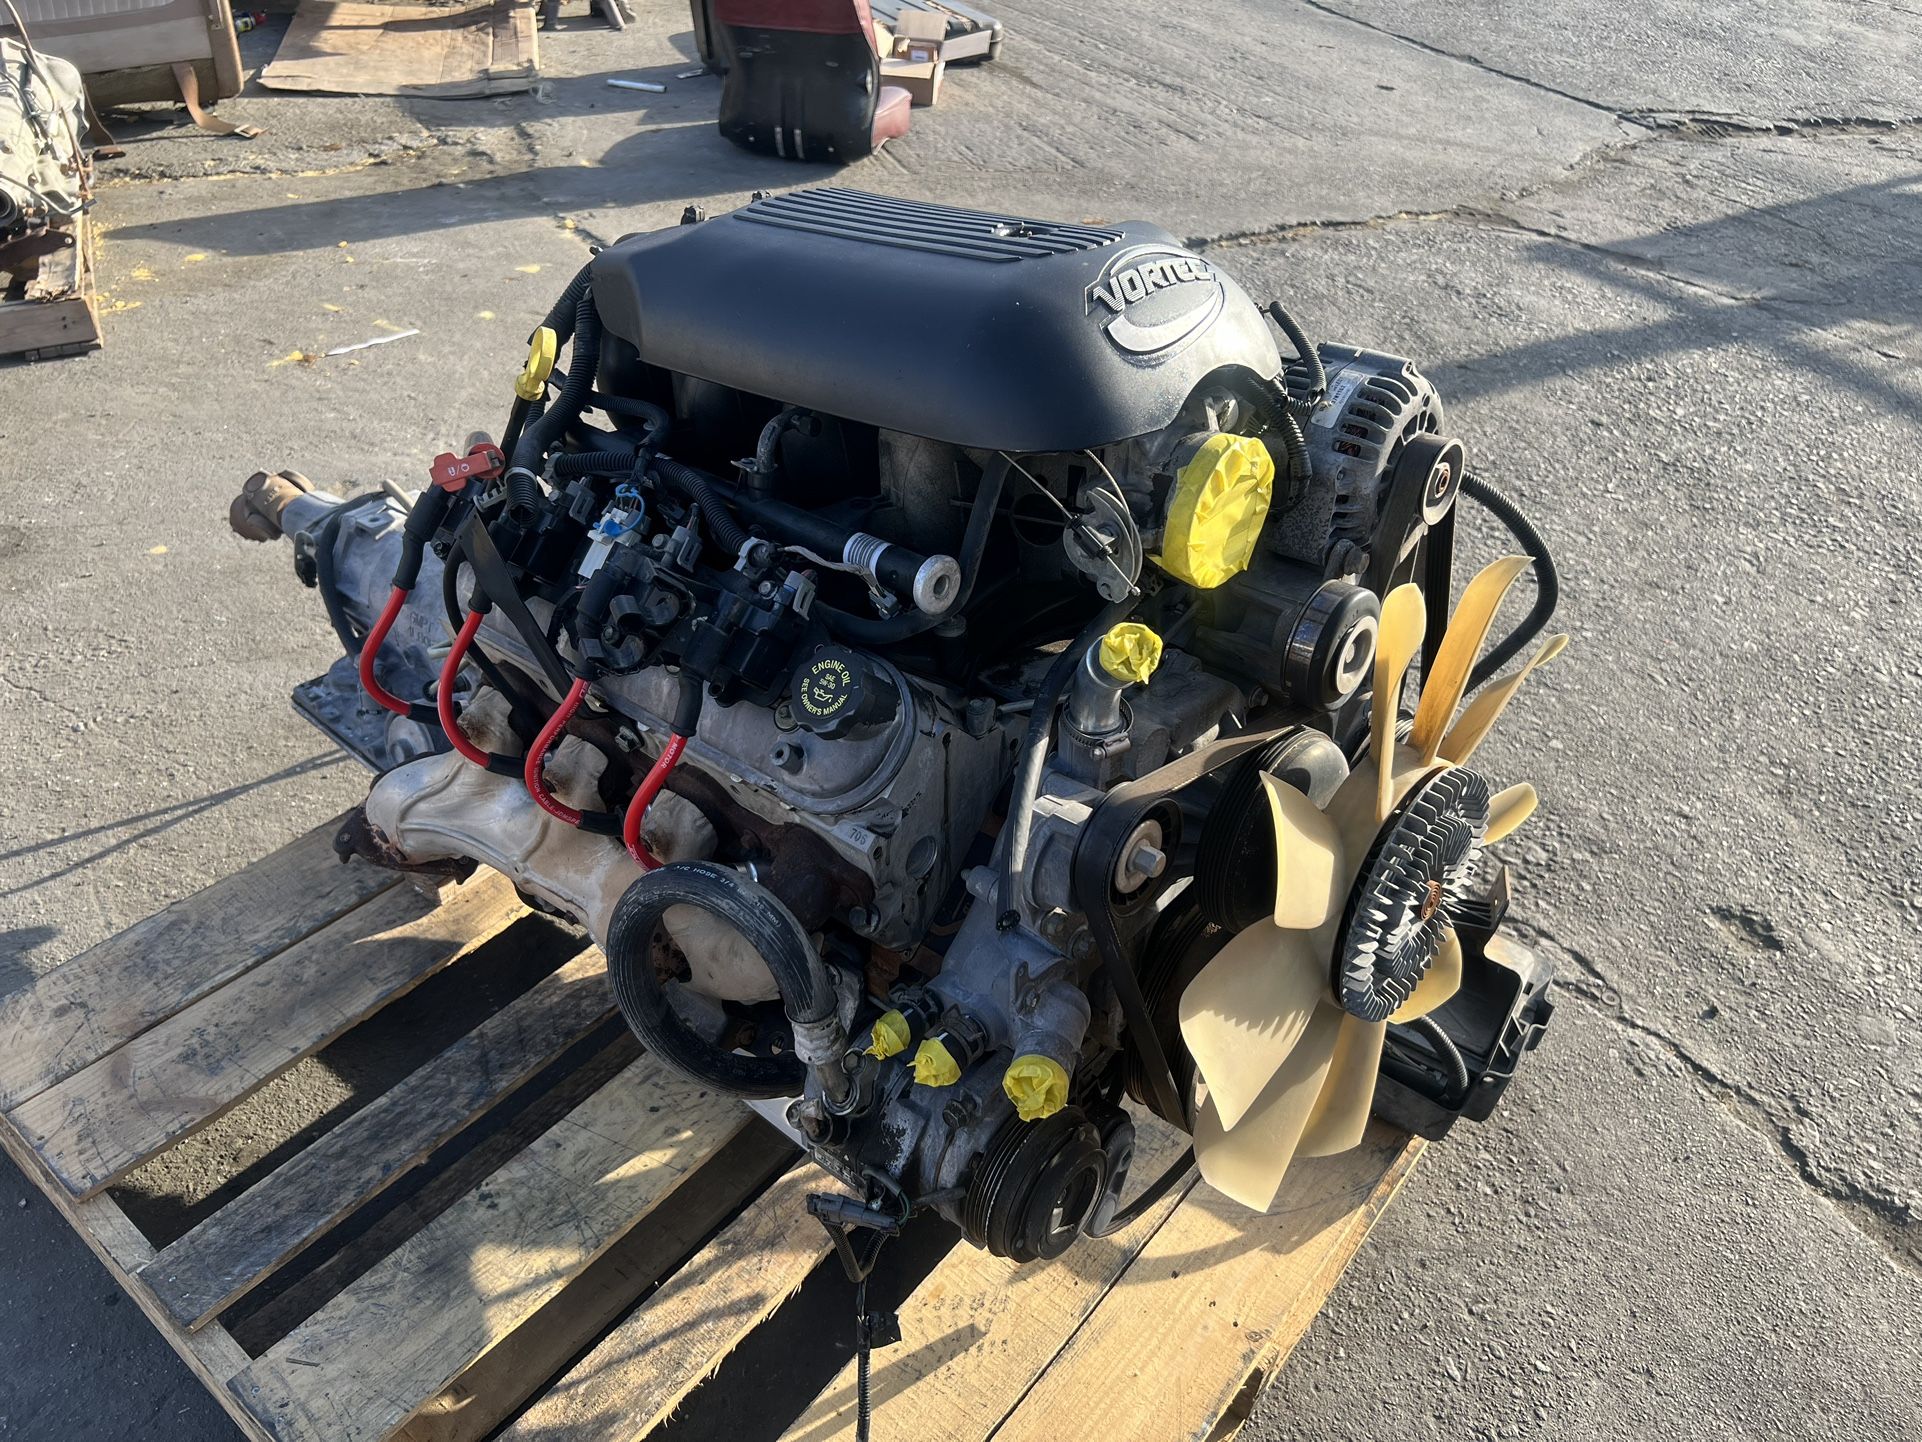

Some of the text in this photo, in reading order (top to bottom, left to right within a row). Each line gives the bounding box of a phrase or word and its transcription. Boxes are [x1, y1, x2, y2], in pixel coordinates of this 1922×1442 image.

[1092, 257, 1211, 312] VORTEC
[811, 659, 851, 687] ENGINE OIL
[824, 673, 836, 682] SAE
[800, 677, 848, 716] SEE OWNER'S MANUAL
[660, 743, 678, 769] MOTOR
[693, 868, 718, 878] HOSE
[720, 878, 735, 887] 3/4
